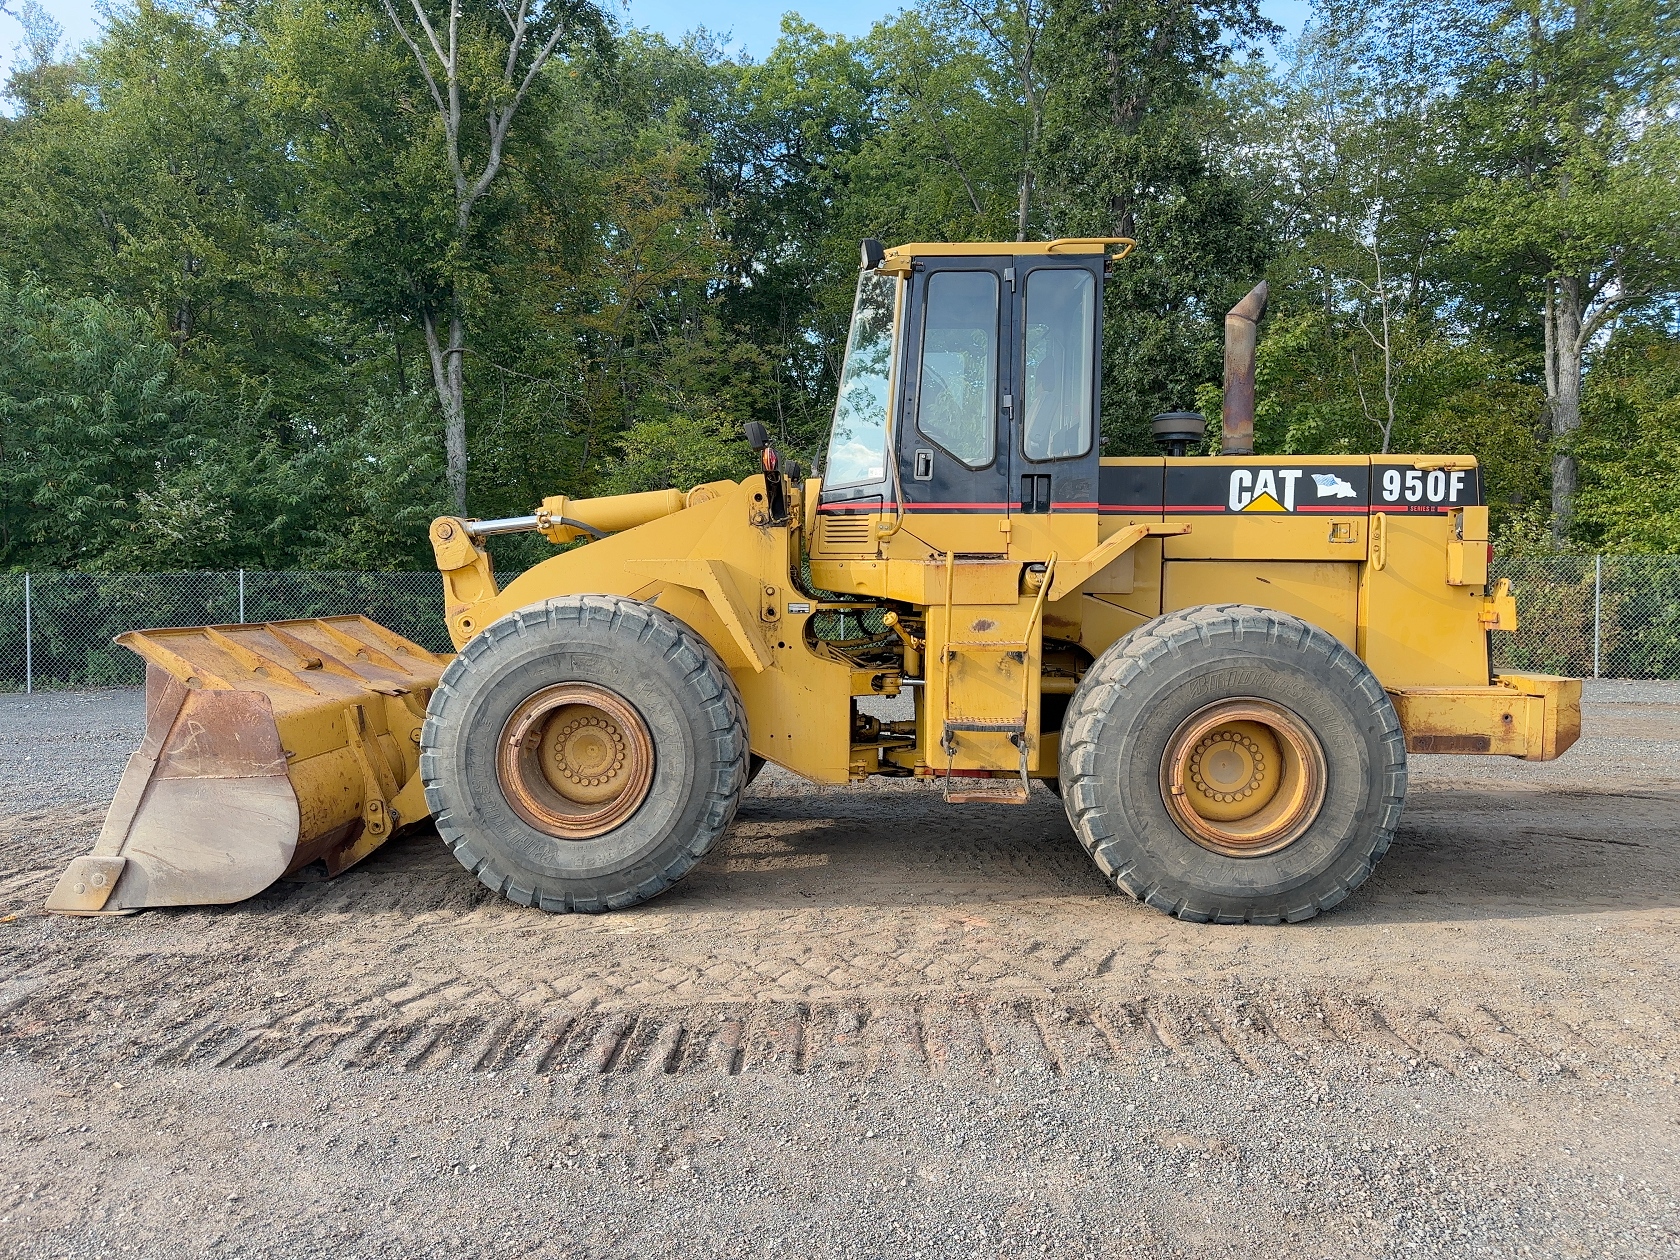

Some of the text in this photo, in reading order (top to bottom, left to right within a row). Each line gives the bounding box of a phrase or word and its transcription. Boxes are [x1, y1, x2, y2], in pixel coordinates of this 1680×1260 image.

[1229, 469, 1302, 512] CAT
[1382, 469, 1465, 502] 950F
[1188, 669, 1351, 749] BRIDGESTONE
